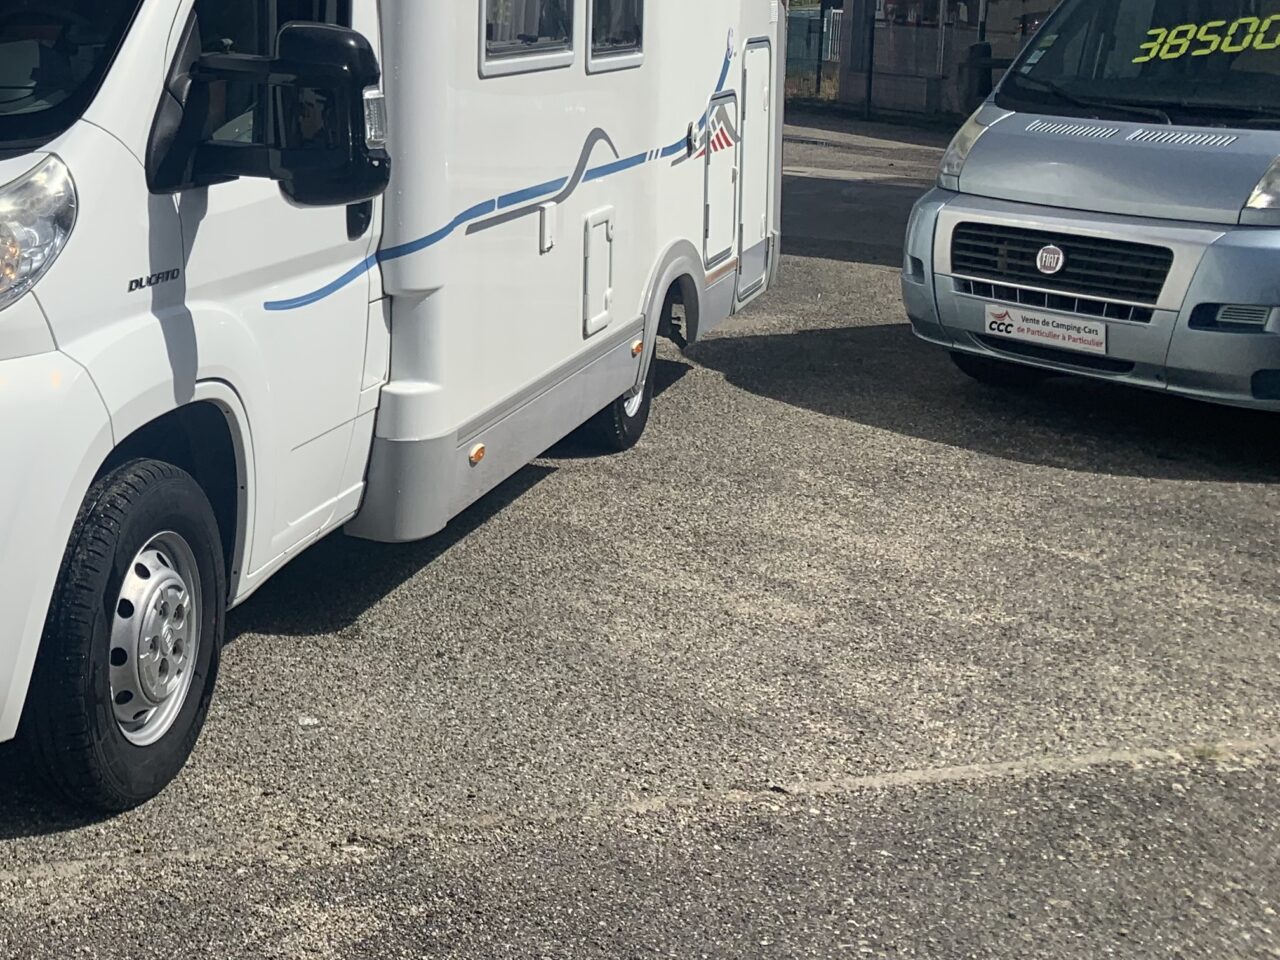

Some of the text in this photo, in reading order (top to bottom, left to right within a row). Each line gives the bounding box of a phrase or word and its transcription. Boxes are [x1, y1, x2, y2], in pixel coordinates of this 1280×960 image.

[1041, 252, 1059, 267] FIAT
[128, 268, 180, 293] DUCATO
[1021, 315, 1099, 336] Vente de Camping-Cars
[1016, 326, 1026, 334] de
[1026, 327, 1061, 340] Particulier
[1067, 334, 1104, 348] Particulier
